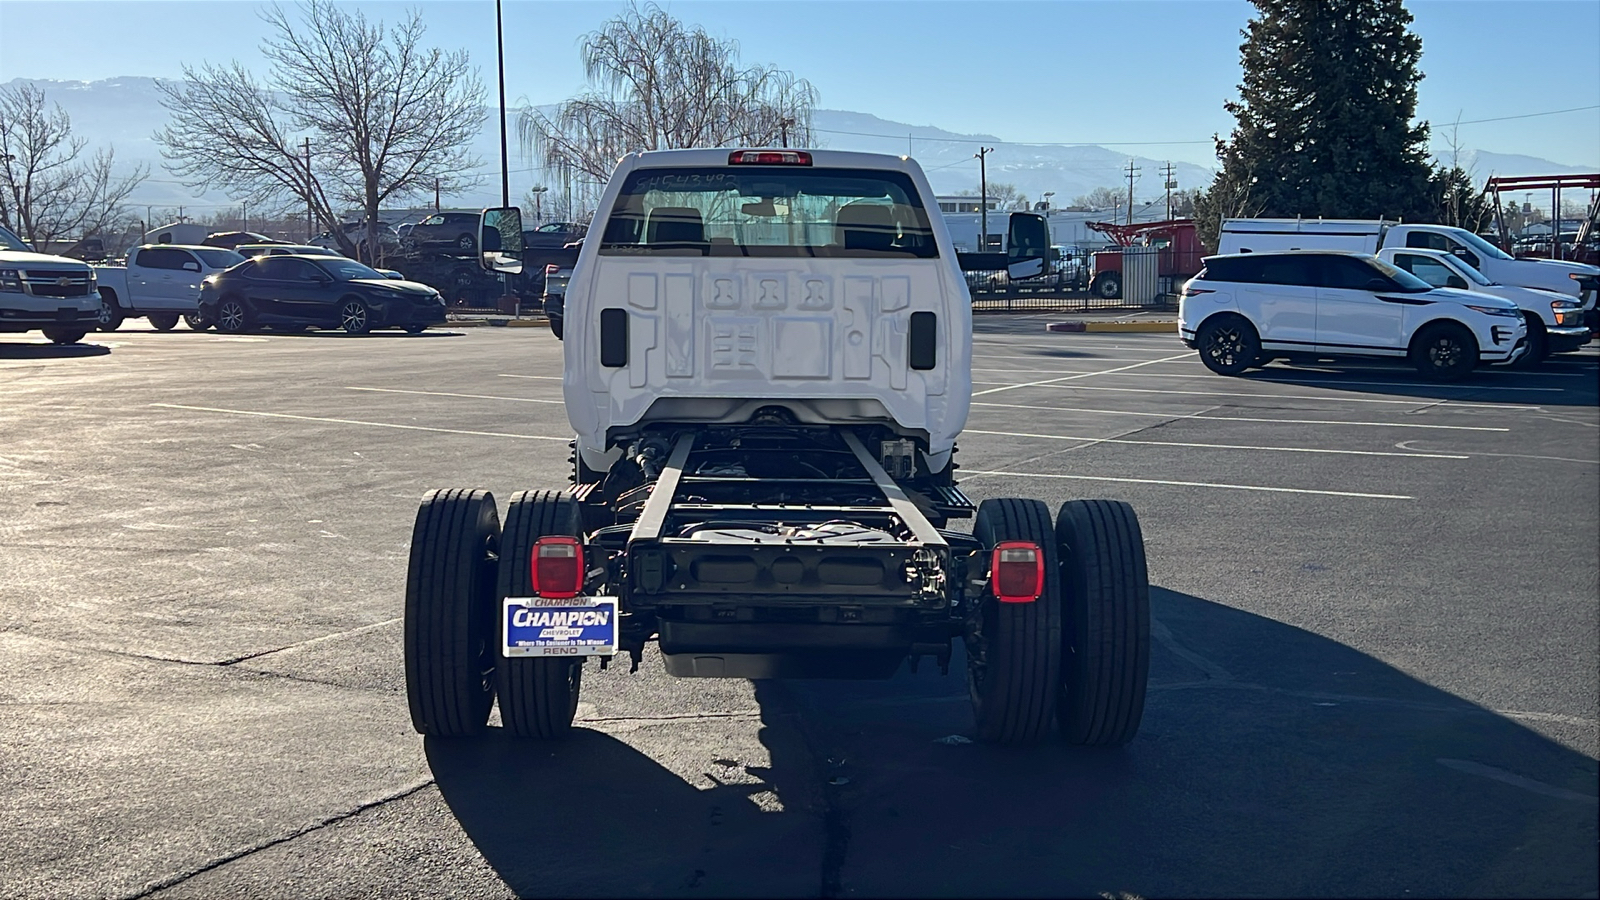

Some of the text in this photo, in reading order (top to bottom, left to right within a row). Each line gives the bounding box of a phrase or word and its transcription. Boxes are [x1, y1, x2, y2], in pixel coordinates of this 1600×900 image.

[534, 598, 587, 607] CHAMPION
[512, 608, 610, 627] CHAMPION
[542, 629, 580, 637] CHEVROLET
[543, 647, 578, 655] RENO
